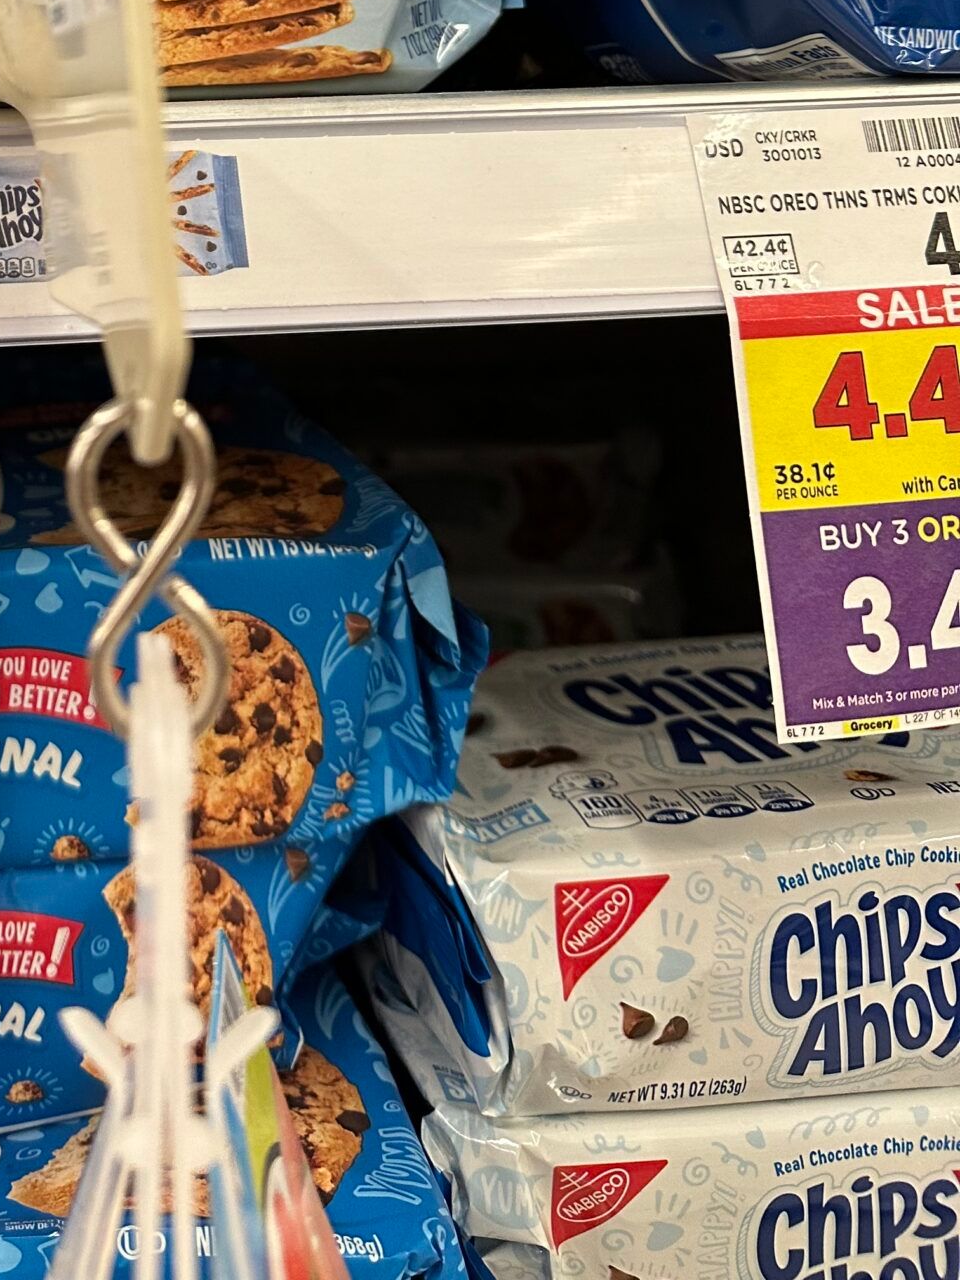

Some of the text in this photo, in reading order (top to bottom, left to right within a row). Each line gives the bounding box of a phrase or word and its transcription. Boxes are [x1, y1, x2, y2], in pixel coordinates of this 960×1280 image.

[755, 130, 817, 145] CKY/CRKR
[762, 148, 822, 162] 3001013
[896, 156, 911, 168] 12
[718, 186, 917, 215] NBSC OREO THNS TRMS
[856, 291, 960, 329] SALE
[776, 484, 839, 501] PER OUNCE
[902, 476, 934, 495] with
[819, 515, 960, 551] BUY 3 OR
[209, 537, 276, 560] NET WT
[31, 657, 72, 681] LOVE
[812, 688, 939, 711] Mix & Match 3 or more
[851, 719, 893, 733] Grocery
[913, 713, 929, 724] 227
[777, 848, 915, 893] Real Chocolate Chip
[567, 889, 627, 952] NABISCO
[770, 891, 960, 1019] Chips
[608, 1076, 748, 1105] NET WT 9.31 OZ (263g)
[774, 1137, 914, 1177] Real Chocolate Chip
[562, 1173, 623, 1219] NABISCO
[757, 1175, 958, 1280] Chips
